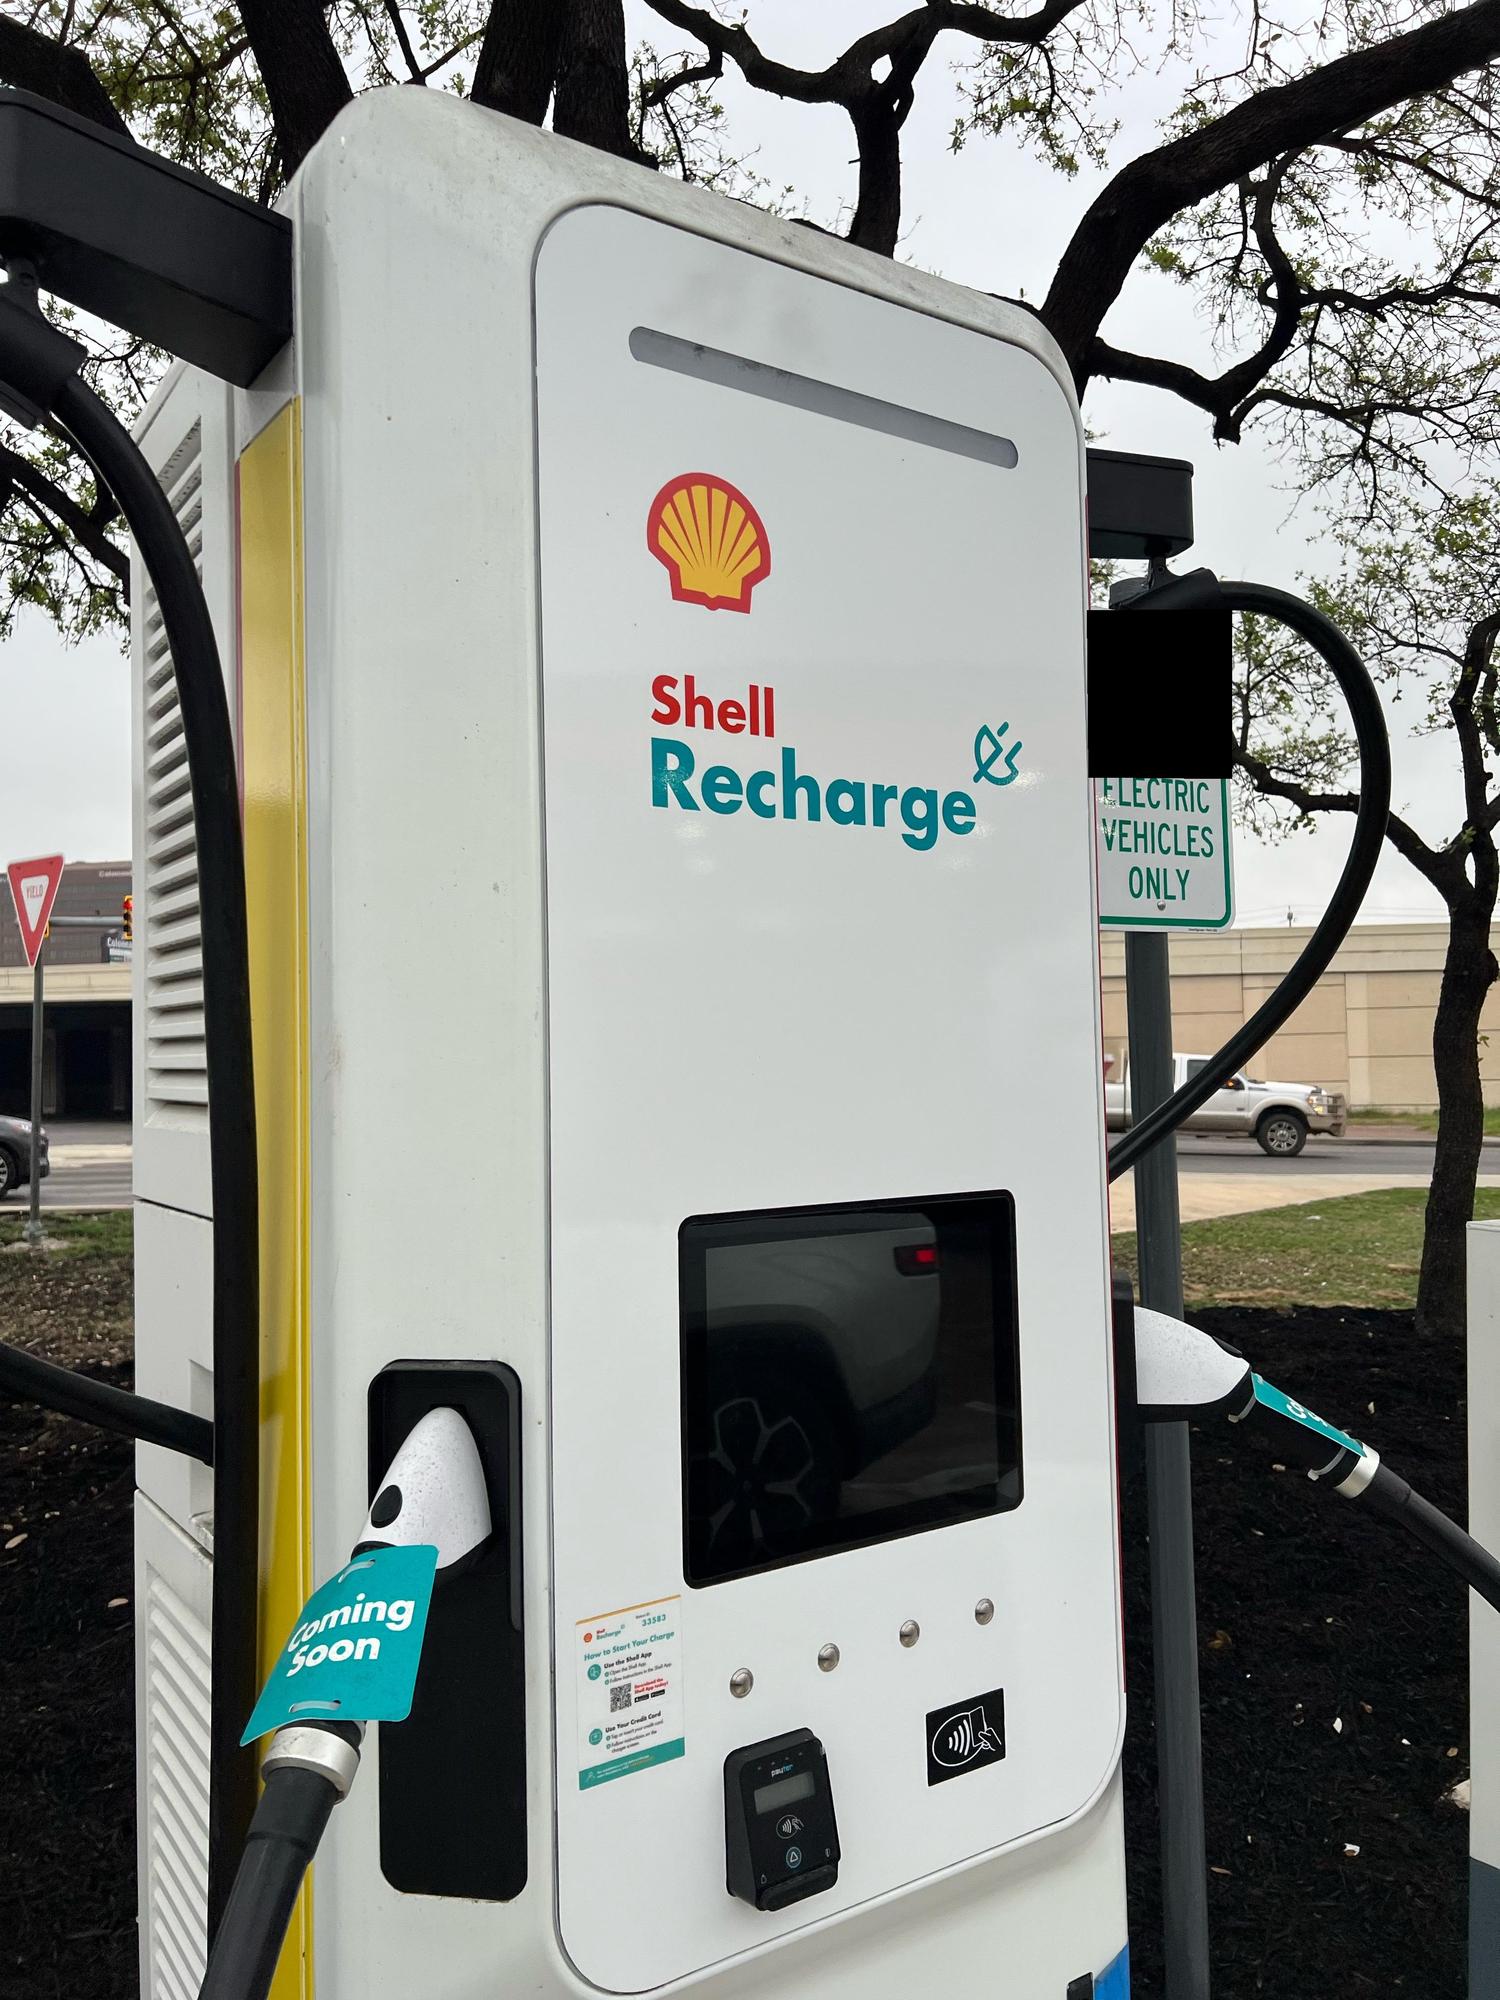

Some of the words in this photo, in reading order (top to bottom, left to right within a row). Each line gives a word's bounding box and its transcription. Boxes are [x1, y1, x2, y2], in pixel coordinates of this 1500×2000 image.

[651, 674, 774, 738] Shell
[650, 737, 977, 851] Recharge
[1103, 777, 1210, 813] ELECTRIC
[1101, 818, 1214, 858] VEHICLES
[26, 884, 44, 898] YIELD
[1128, 866, 1190, 901] ONLY
[287, 1592, 415, 1652] Coming
[286, 1637, 381, 1677] Soon
[584, 1651, 601, 1661] How
[603, 1648, 611, 1656] to
[612, 1643, 630, 1653] Start
[632, 1638, 648, 1647] Your
[649, 1631, 675, 1642] Charge
[626, 1653, 640, 1663] Shell
[630, 1715, 647, 1725] Credit
[648, 1710, 661, 1720] Card
